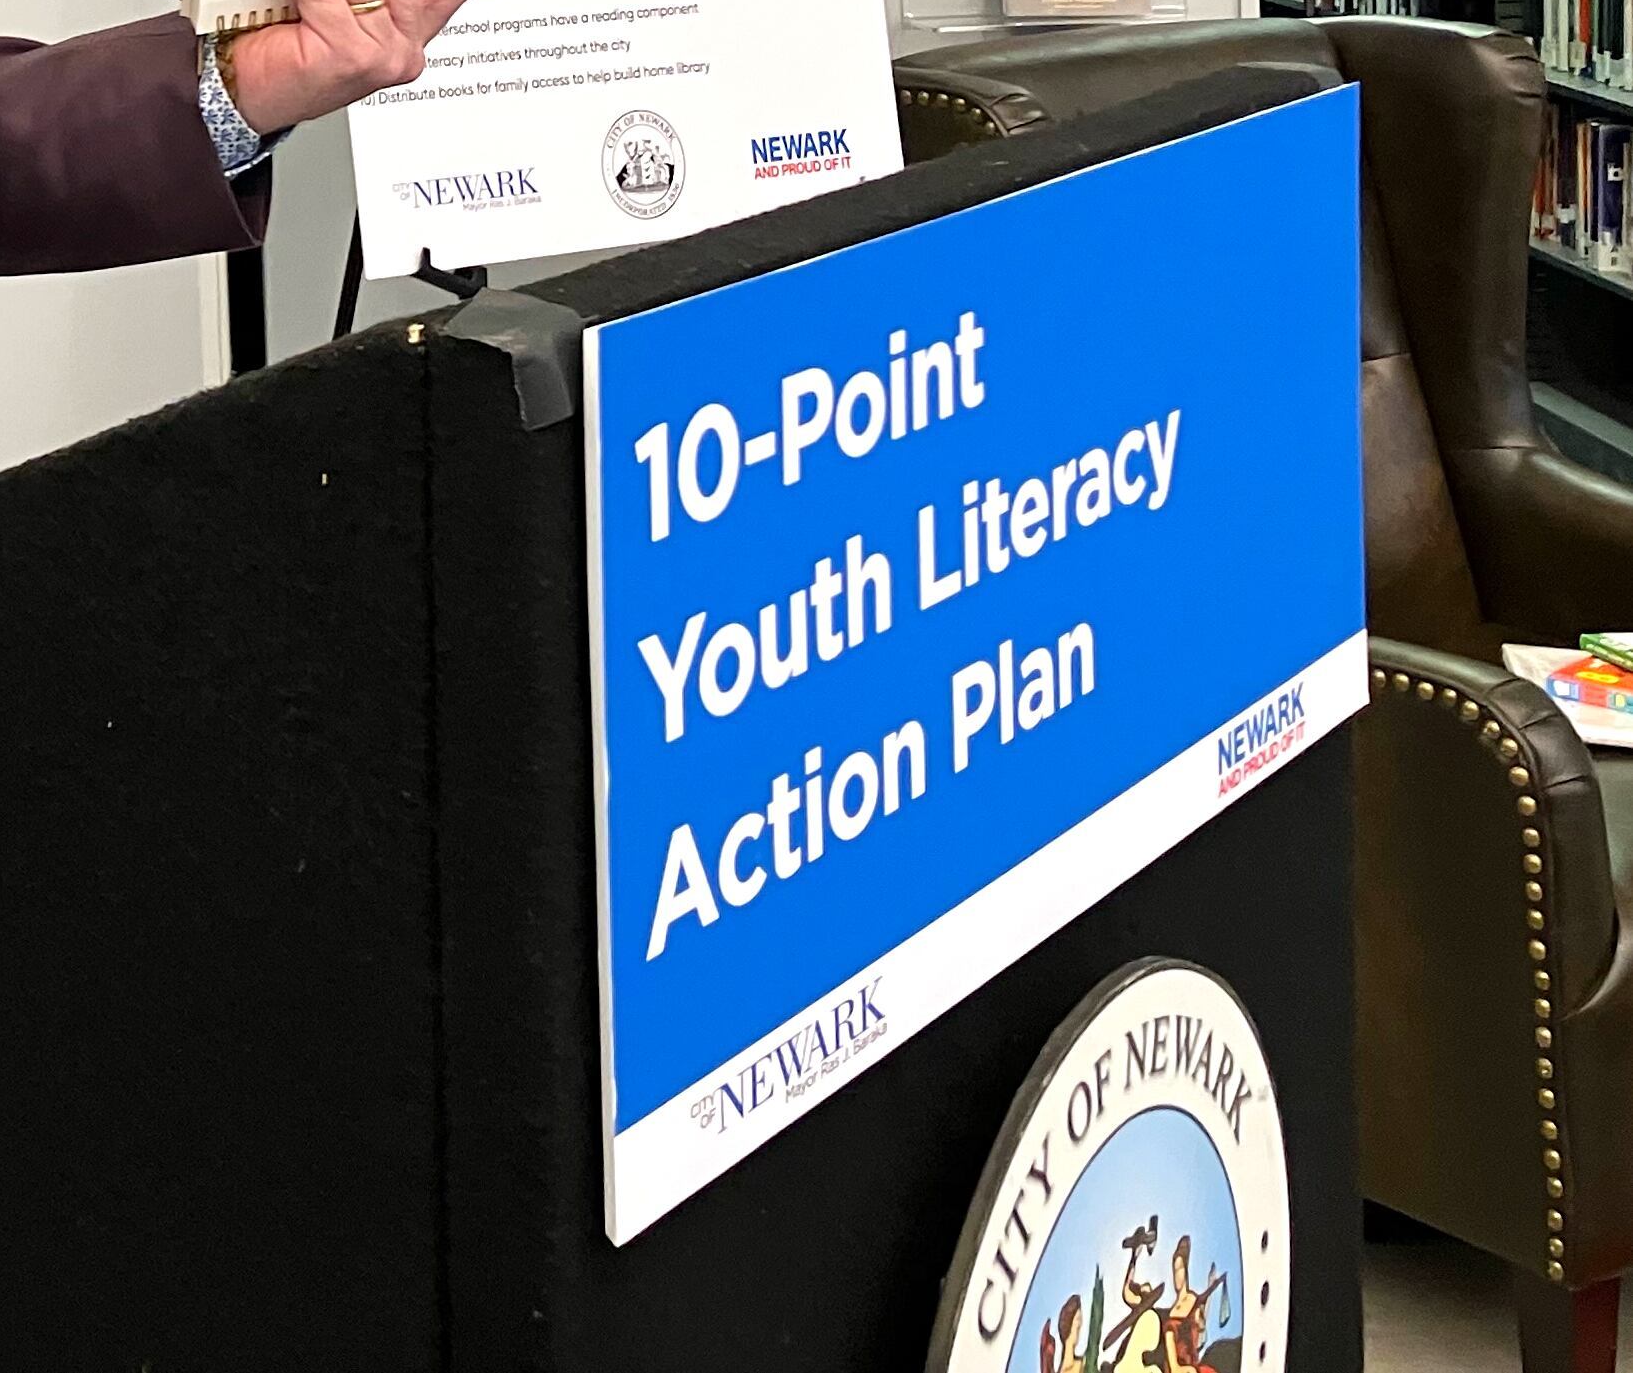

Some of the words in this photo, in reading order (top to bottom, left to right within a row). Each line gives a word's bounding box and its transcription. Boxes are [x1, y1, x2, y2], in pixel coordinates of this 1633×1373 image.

[493, 17, 549, 34] programs
[551, 14, 578, 26] have
[581, 16, 589, 24] a
[591, 8, 634, 24] reading
[637, 3, 700, 21] component
[467, 48, 522, 64] initiatives
[524, 42, 588, 60] throughout
[590, 40, 609, 52] the
[611, 38, 631, 52] city
[379, 88, 436, 105] Distribute
[439, 84, 474, 99] books
[477, 82, 492, 94] for
[494, 79, 529, 94] family
[532, 76, 570, 88] access
[572, 73, 585, 85] to
[587, 69, 612, 84] help
[614, 66, 641, 81] build
[643, 63, 675, 78] home
[676, 60, 711, 77] library
[623, 114, 635, 127] OF
[638, 113, 678, 140] NEWARK
[751, 128, 851, 164] NEWARK
[412, 167, 539, 209] NEWARK
[754, 165, 780, 180] AND
[781, 160, 822, 176] PROUD
[824, 158, 840, 171] OF
[841, 156, 852, 169] IT
[634, 310, 985, 542] 10-Point
[638, 535, 892, 743] Youth
[918, 409, 1181, 607] Literacy
[1217, 681, 1305, 776] NEWARK
[1217, 768, 1242, 799] AND
[1244, 740, 1279, 780] PROUD
[1281, 728, 1295, 753] OF
[1295, 720, 1306, 742] IT
[645, 742, 927, 961] Action
[952, 618, 1096, 776] Plan
[715, 975, 885, 1135] NEWARK
[785, 1070, 819, 1104] Mayor
[820, 1058, 841, 1080] Ras
[852, 1022, 888, 1056] Baraka
[690, 1089, 717, 1119] CITY
[700, 1106, 717, 1129] OF
[977, 1132, 1056, 1345] CITY
[1067, 1048, 1114, 1144] OF
[1123, 1013, 1254, 1146] NEWARK
